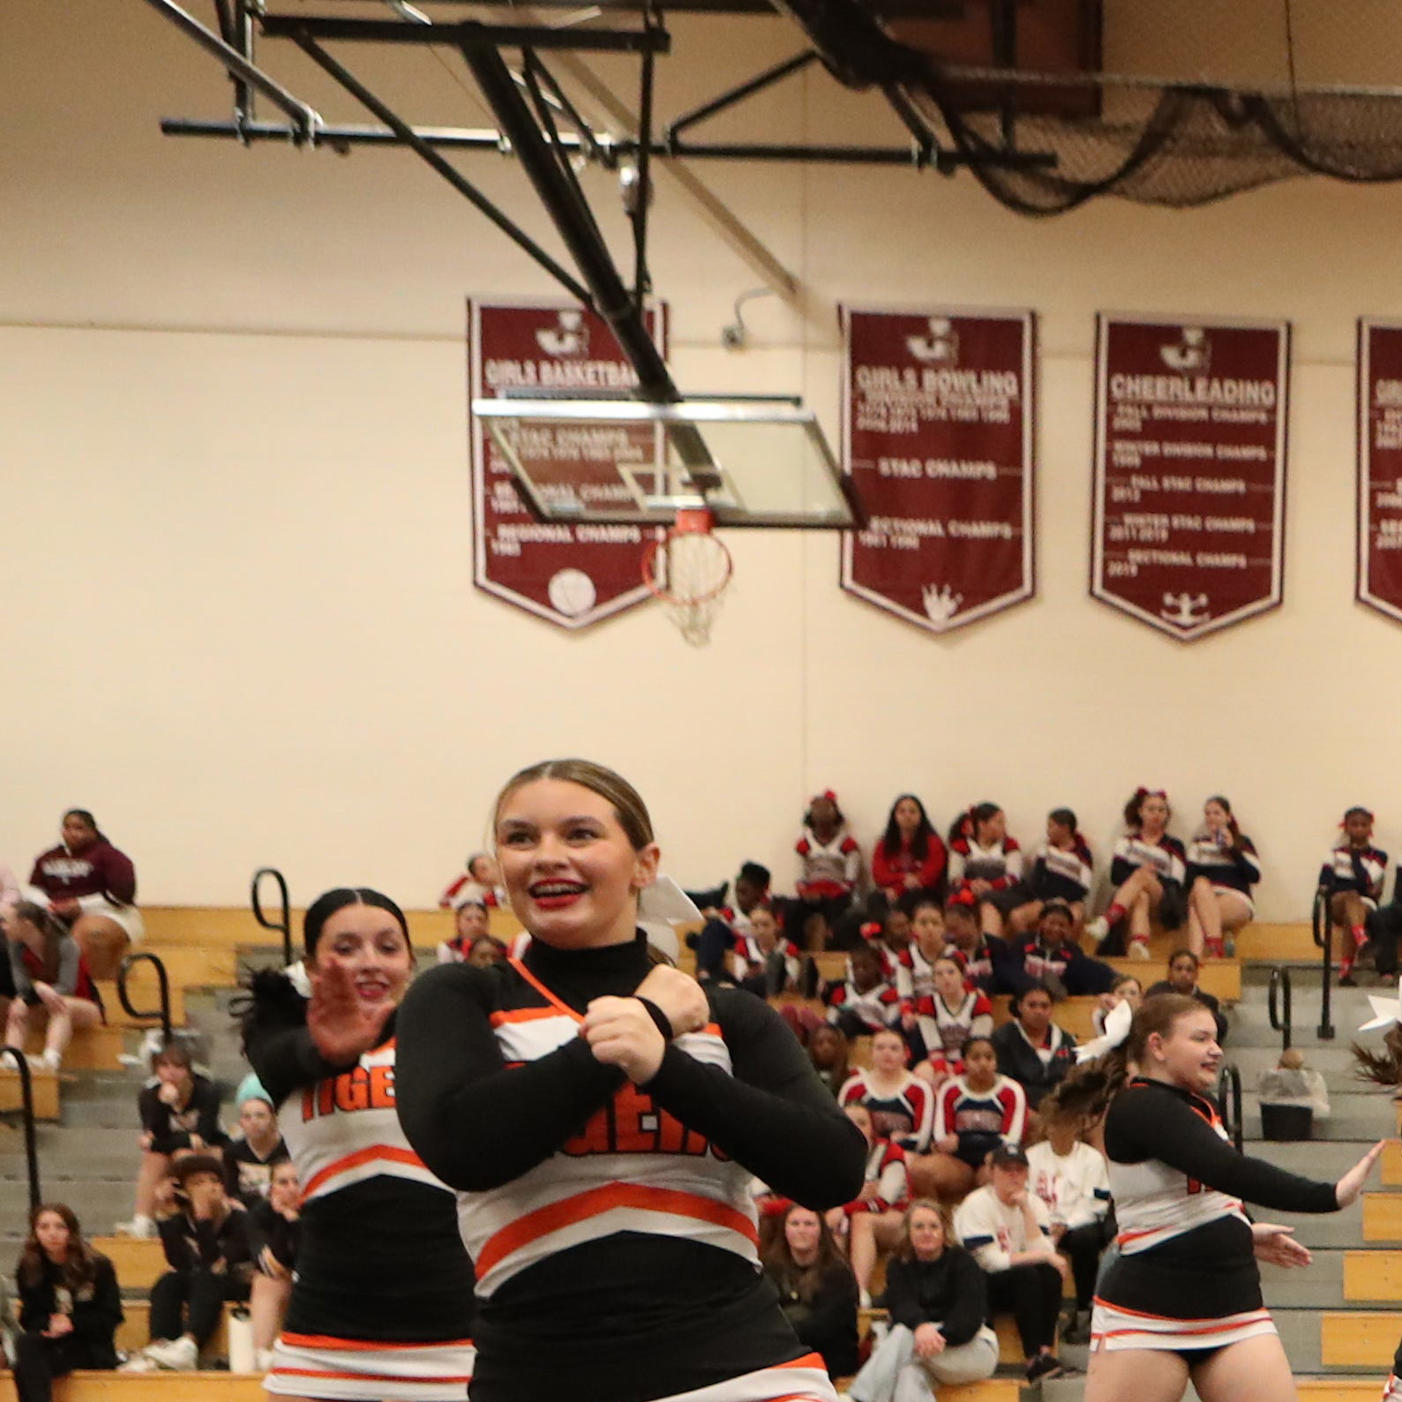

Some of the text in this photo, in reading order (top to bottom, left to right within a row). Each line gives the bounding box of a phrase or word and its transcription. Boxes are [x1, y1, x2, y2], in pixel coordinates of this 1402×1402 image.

[485, 359, 640, 387] GIRLS BASKETBA
[856, 366, 1018, 397] GIRLS BOWLING
[1110, 373, 1276, 407] CHEERLEADING
[878, 458, 998, 480] STAC CHAMPS
[1194, 476, 1247, 494] CHAMPS
[497, 523, 642, 543] REGIONAL CHAMPS
[868, 515, 1013, 539] ECTIONAL CHAMPS
[1171, 513, 1203, 530] STAC
[1204, 515, 1256, 533] CHAMPS
[1127, 549, 1248, 569] SECTIONAL CHAMPS
[301, 1066, 396, 1123] TIGE
